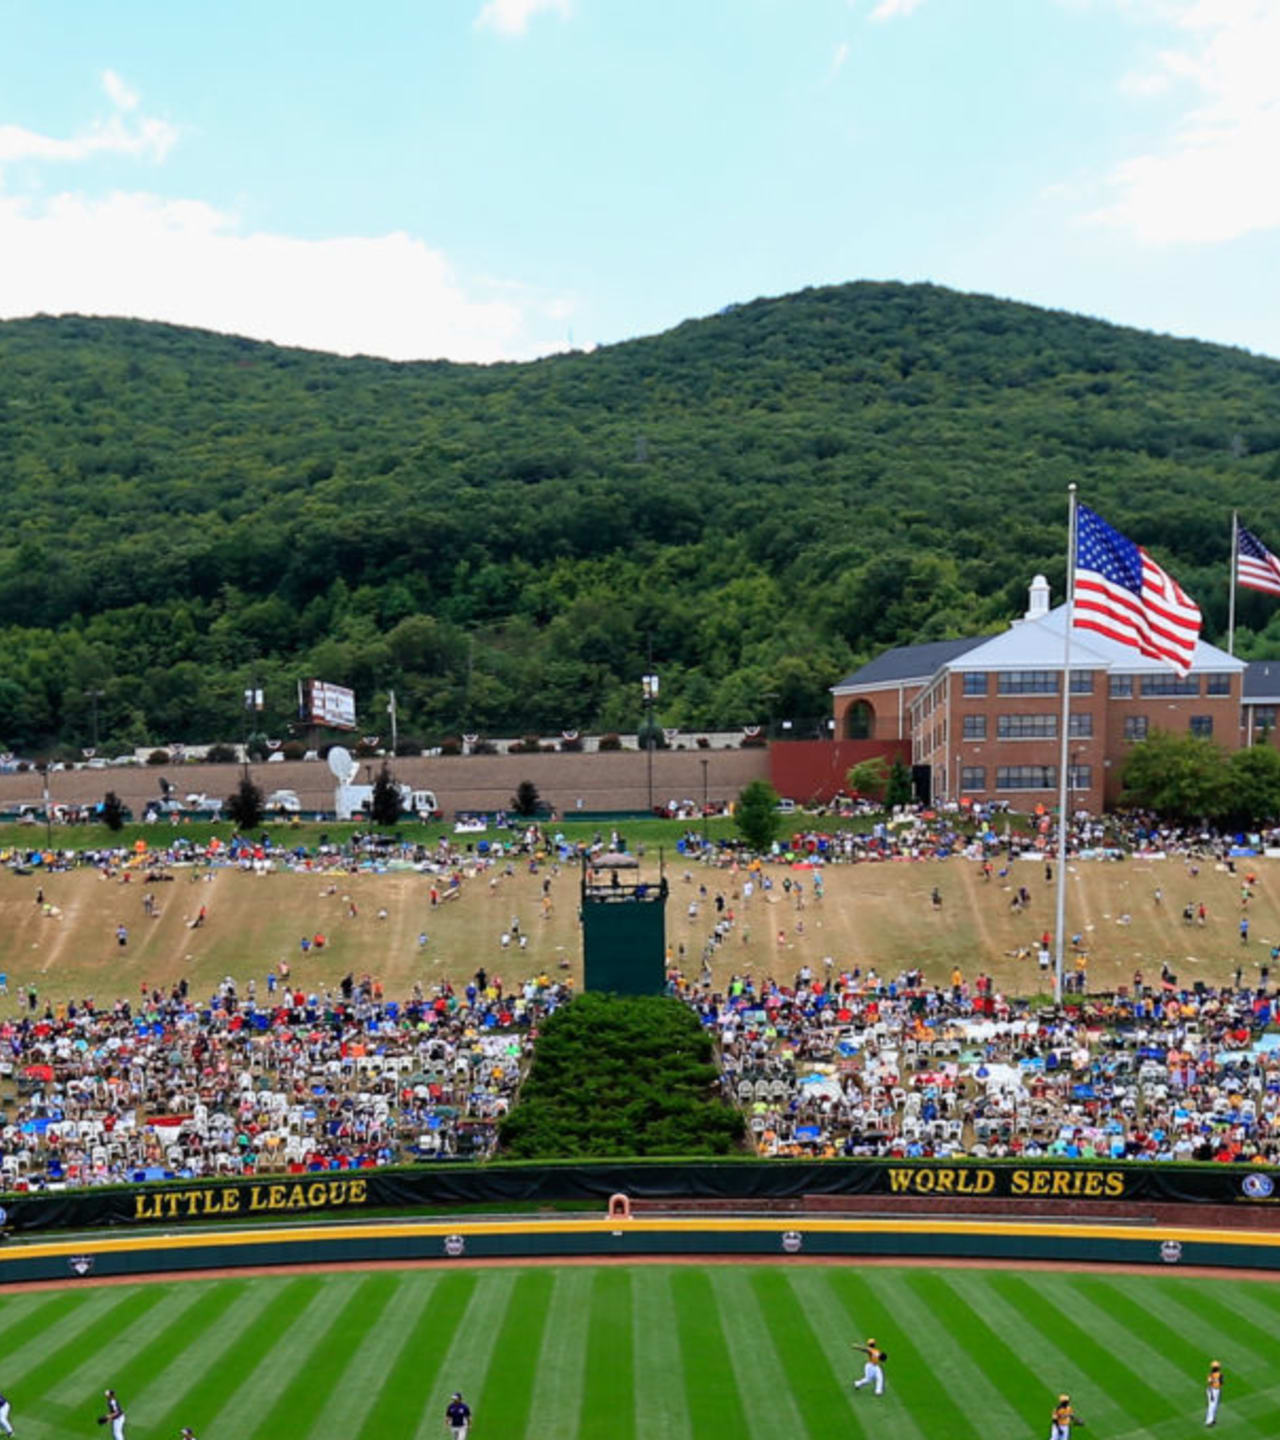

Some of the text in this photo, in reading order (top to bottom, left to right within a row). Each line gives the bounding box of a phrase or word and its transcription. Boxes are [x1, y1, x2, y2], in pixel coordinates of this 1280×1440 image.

[888, 1169, 1125, 1195] WORLD SERIES
[135, 1179, 367, 1218] LITTLE LEAGUE
